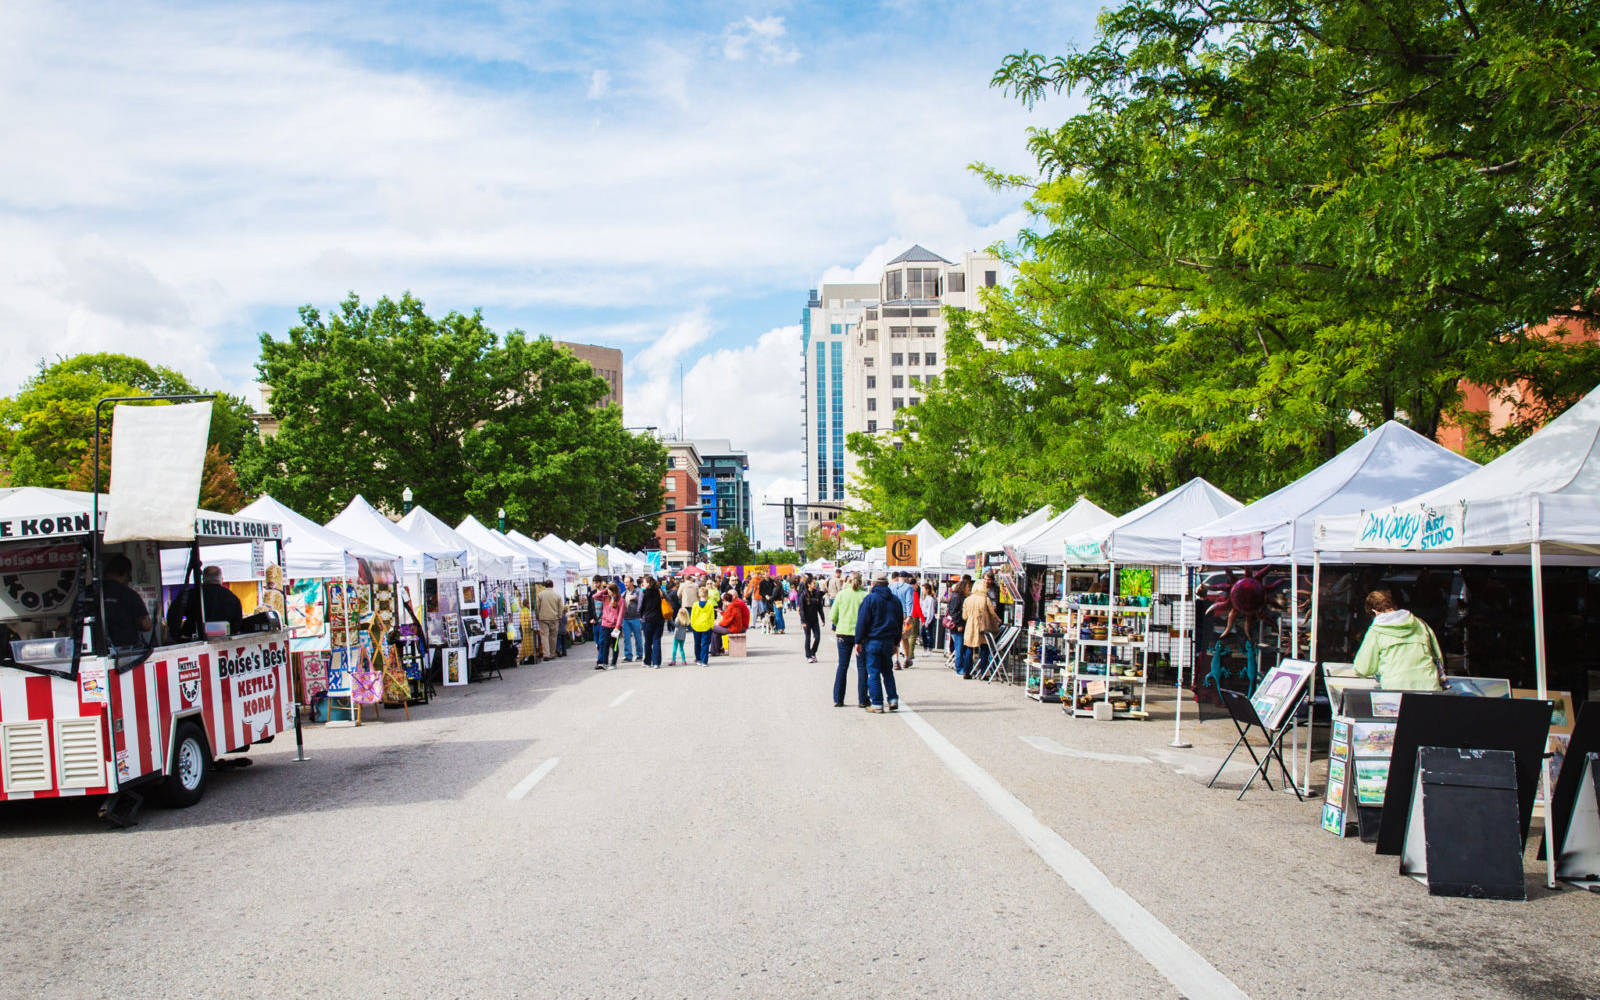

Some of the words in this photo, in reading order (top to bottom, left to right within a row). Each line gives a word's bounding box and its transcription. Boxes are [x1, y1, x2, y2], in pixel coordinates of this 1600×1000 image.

[21, 515, 90, 534] KORN
[202, 519, 241, 536] KETTLE
[243, 522, 270, 537] KORN
[1361, 512, 1388, 541] DAN
[1425, 514, 1445, 533] ART
[1421, 526, 1454, 550] STUDIO
[2, 569, 76, 608] KORN
[218, 652, 260, 677] Boise's
[262, 647, 286, 667] Best
[237, 673, 274, 697] KETTLE
[243, 695, 271, 717] KORN
